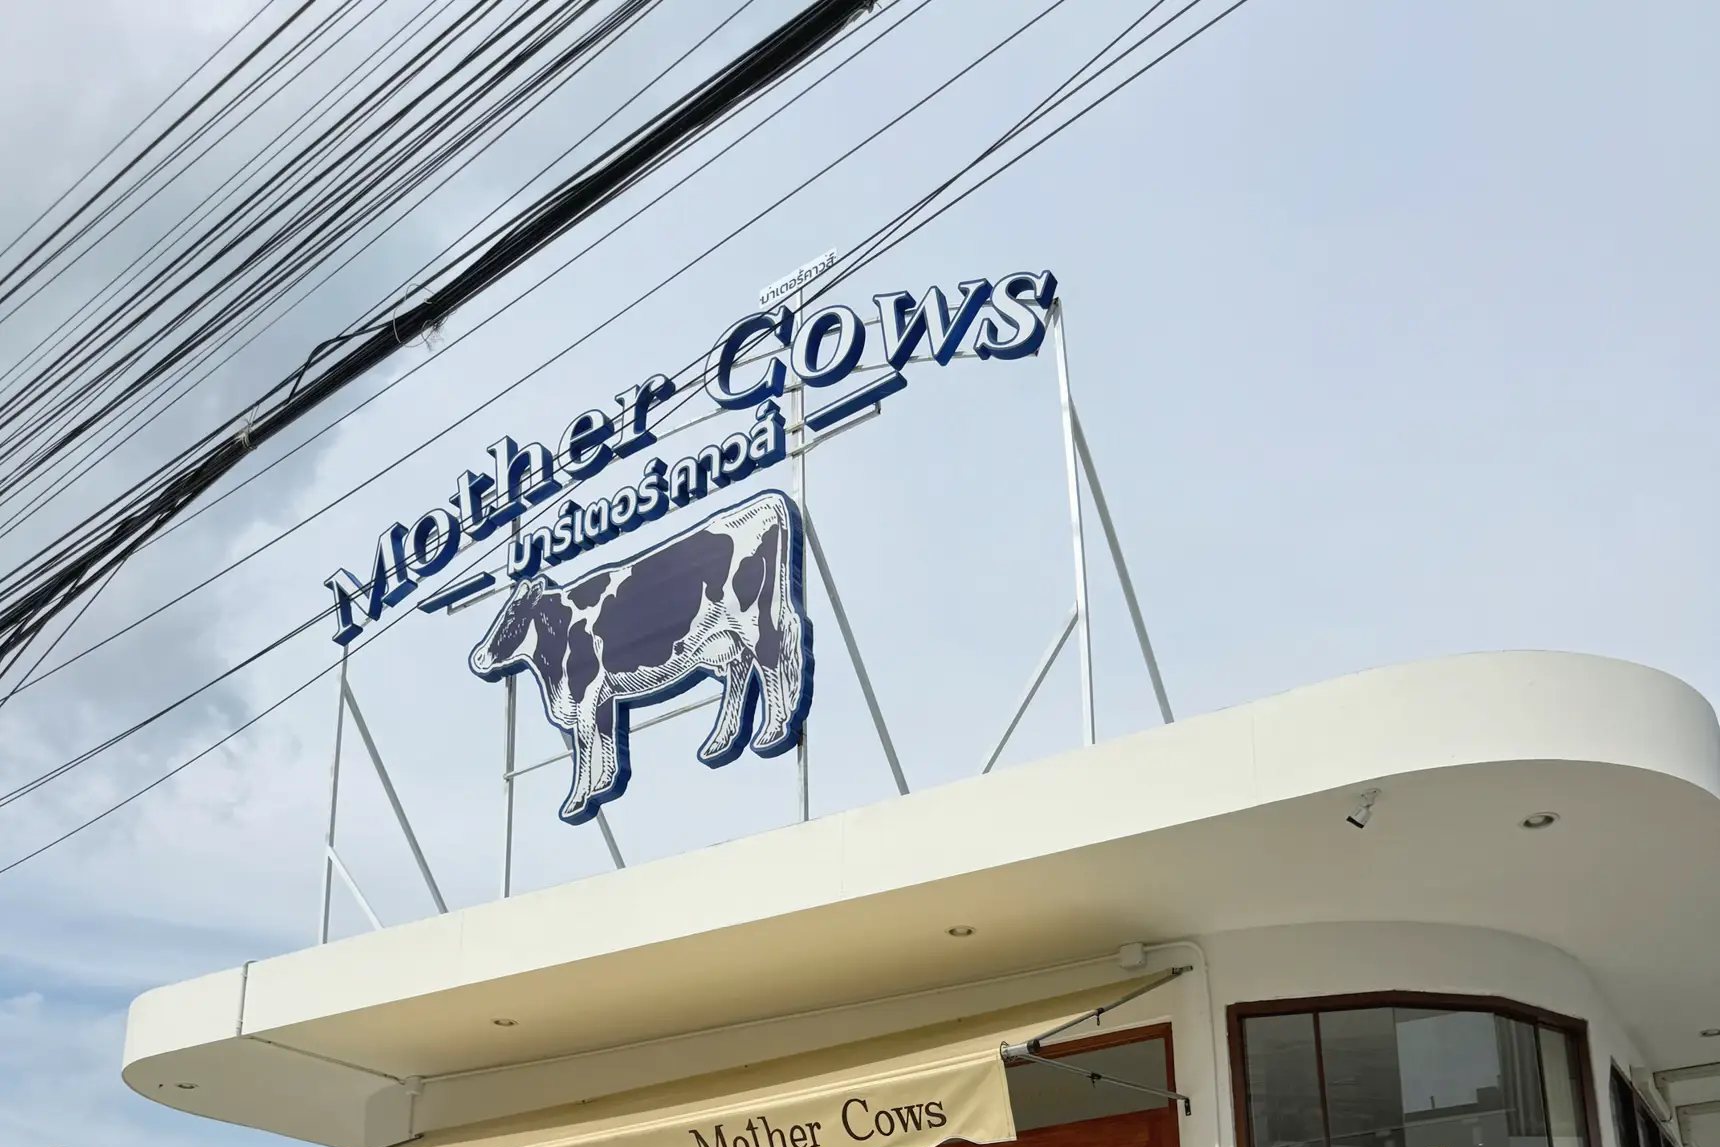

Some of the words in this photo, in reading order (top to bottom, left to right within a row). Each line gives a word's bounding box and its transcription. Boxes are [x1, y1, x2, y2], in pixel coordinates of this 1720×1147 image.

[324, 373, 676, 647] Mother
[704, 270, 1058, 410] Cows
[841, 1098, 947, 1141] Cows
